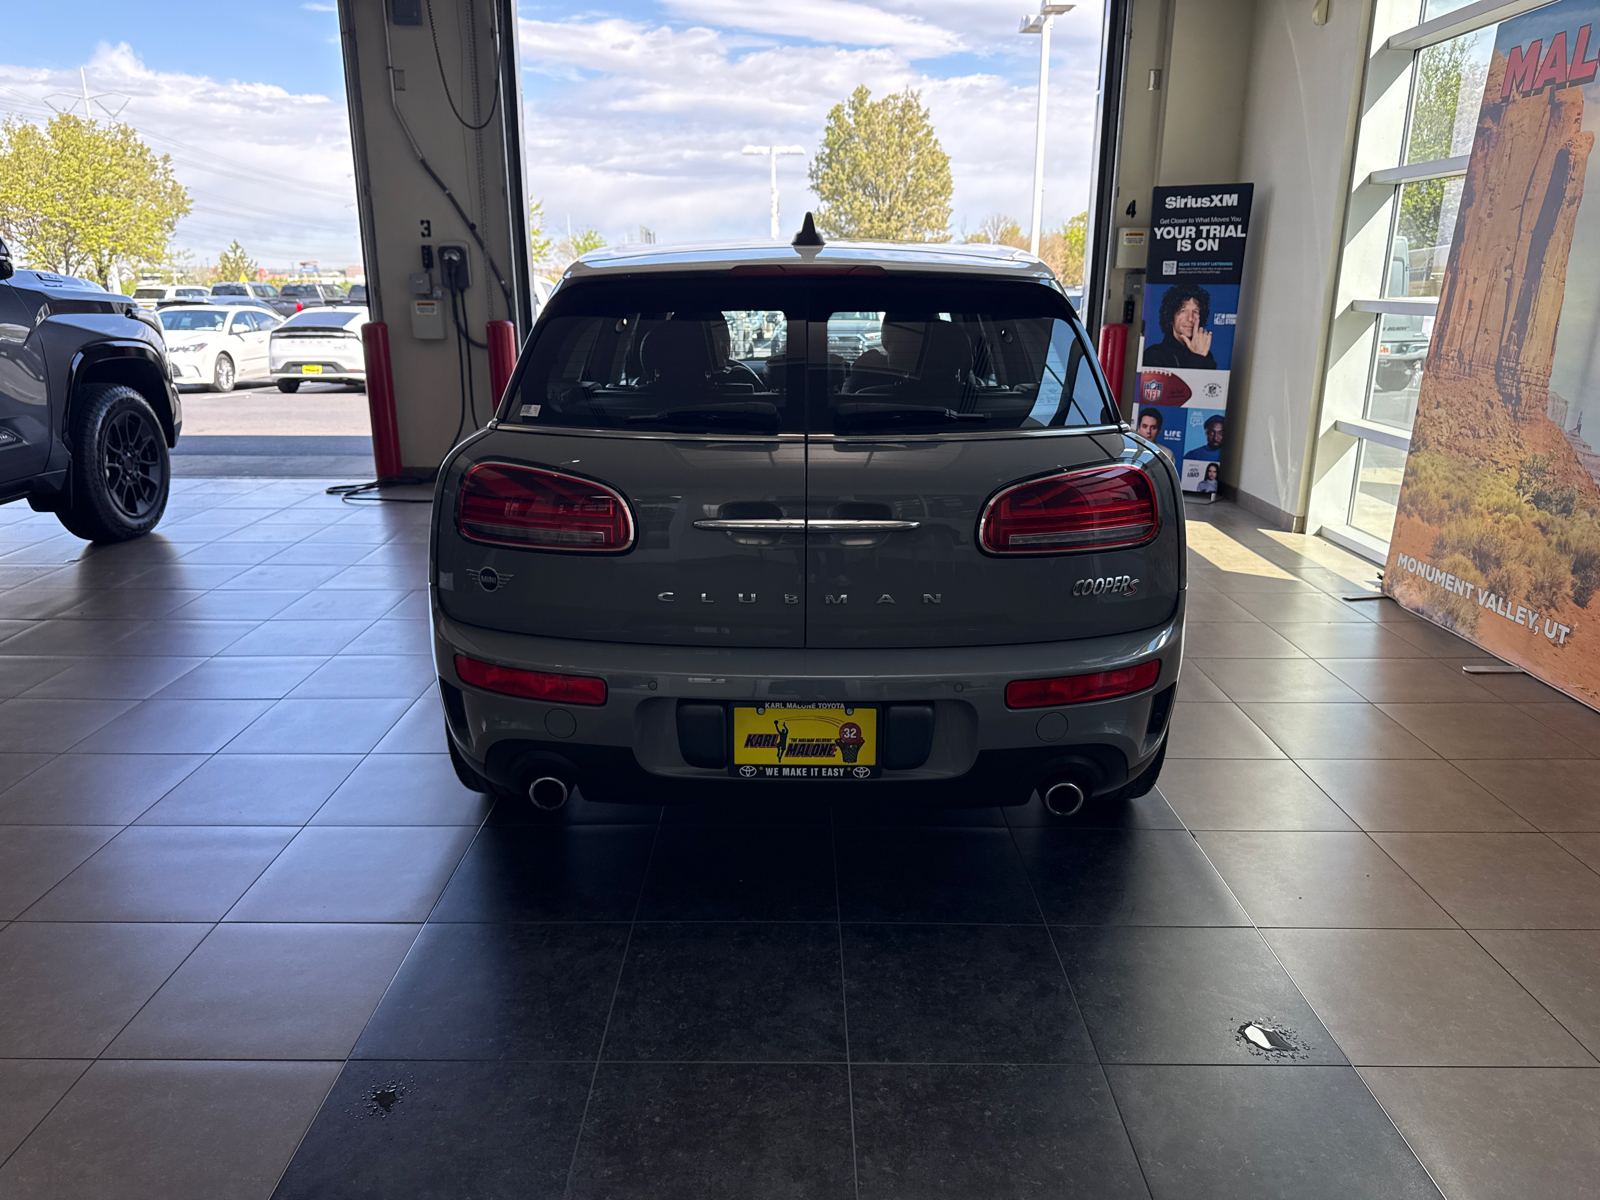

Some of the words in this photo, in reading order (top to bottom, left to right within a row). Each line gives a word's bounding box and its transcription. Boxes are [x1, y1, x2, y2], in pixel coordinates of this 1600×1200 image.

[1500, 23, 1600, 102] MAL
[1165, 193, 1238, 209] SiriusXM
[1126, 200, 1136, 218] 4
[420, 220, 431, 238] 3
[1153, 226, 1196, 240] YOUR
[1199, 225, 1246, 238] TRIAL
[1176, 239, 1192, 252] IS
[1194, 238, 1219, 252] ON
[1145, 390, 1160, 399] NFL
[657, 591, 942, 605] CLUBMAN
[1397, 552, 1474, 600] MONUMENT
[1477, 588, 1539, 635] VALLEY,
[1544, 618, 1570, 644] UT
[843, 728, 857, 738] 32
[744, 734, 779, 748] KARL
[784, 743, 838, 758] MALONE
[765, 767, 779, 776] WE
[782, 767, 808, 776] MAKE
[810, 767, 819, 776] IT
[821, 767, 845, 777] EASY
